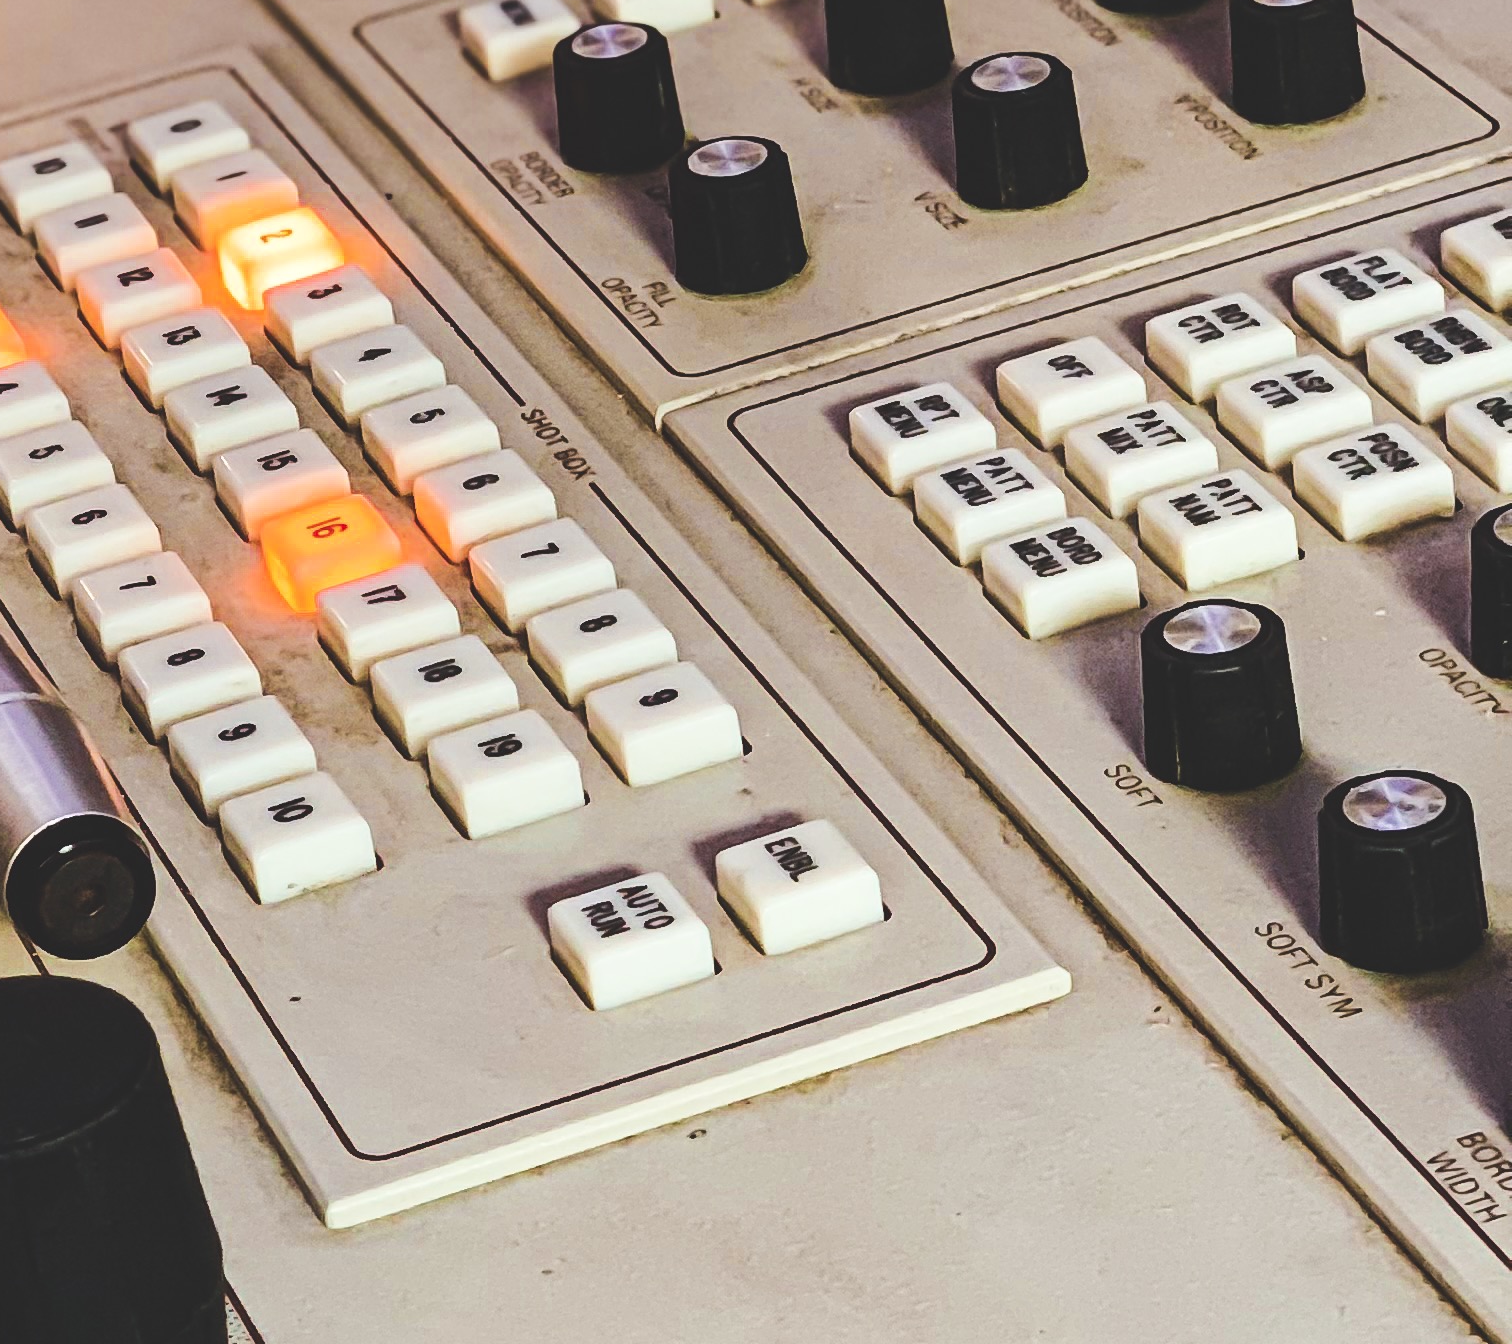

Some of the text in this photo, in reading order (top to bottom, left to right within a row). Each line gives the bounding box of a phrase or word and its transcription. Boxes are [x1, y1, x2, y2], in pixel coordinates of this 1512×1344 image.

[520, 151, 575, 198] BORDER
[260, 229, 292, 243] 2
[117, 267, 154, 287] 12
[1354, 256, 1412, 289] FLAT
[307, 284, 342, 299] 3
[602, 278, 664, 328] OPACITY
[642, 281, 677, 308] FILL
[1178, 315, 1224, 343] CTR
[1210, 304, 1260, 333] ROT
[162, 326, 201, 345] 13
[1048, 355, 1093, 378] OFF
[1250, 379, 1299, 408] CTR
[1284, 370, 1334, 393] ASP
[206, 385, 247, 406] 14
[914, 395, 959, 421] RPT
[410, 408, 445, 424] 5
[874, 401, 928, 438] MENU
[1126, 410, 1186, 447] PATT
[29, 445, 64, 459] 5
[521, 409, 596, 480] SHOT BOX
[1358, 432, 1419, 472] POSN
[257, 450, 297, 471] 15
[1327, 449, 1377, 480] CTR
[463, 474, 499, 490] 6
[940, 468, 996, 506] MENU
[978, 456, 1034, 494] PATT
[1202, 479, 1262, 517] PATT
[72, 510, 107, 524] 6
[307, 517, 349, 539] 16
[521, 543, 559, 558] 7
[1009, 538, 1068, 578] MENU
[1046, 526, 1102, 565] BORD
[120, 576, 156, 590] 7
[361, 585, 406, 604] 17
[580, 615, 617, 632] 8
[167, 649, 205, 666] 8
[418, 659, 462, 682] 18
[639, 689, 678, 707] 9
[218, 723, 256, 741] 9
[478, 734, 522, 757] 19
[1104, 764, 1162, 808] SOFT
[268, 797, 313, 822] 10
[764, 837, 818, 882] ENBL
[581, 901, 631, 938] RUN
[616, 884, 675, 929] AUTO
[1255, 922, 1362, 1020] SOFT SYM
[1427, 1151, 1508, 1223] WIDTH
